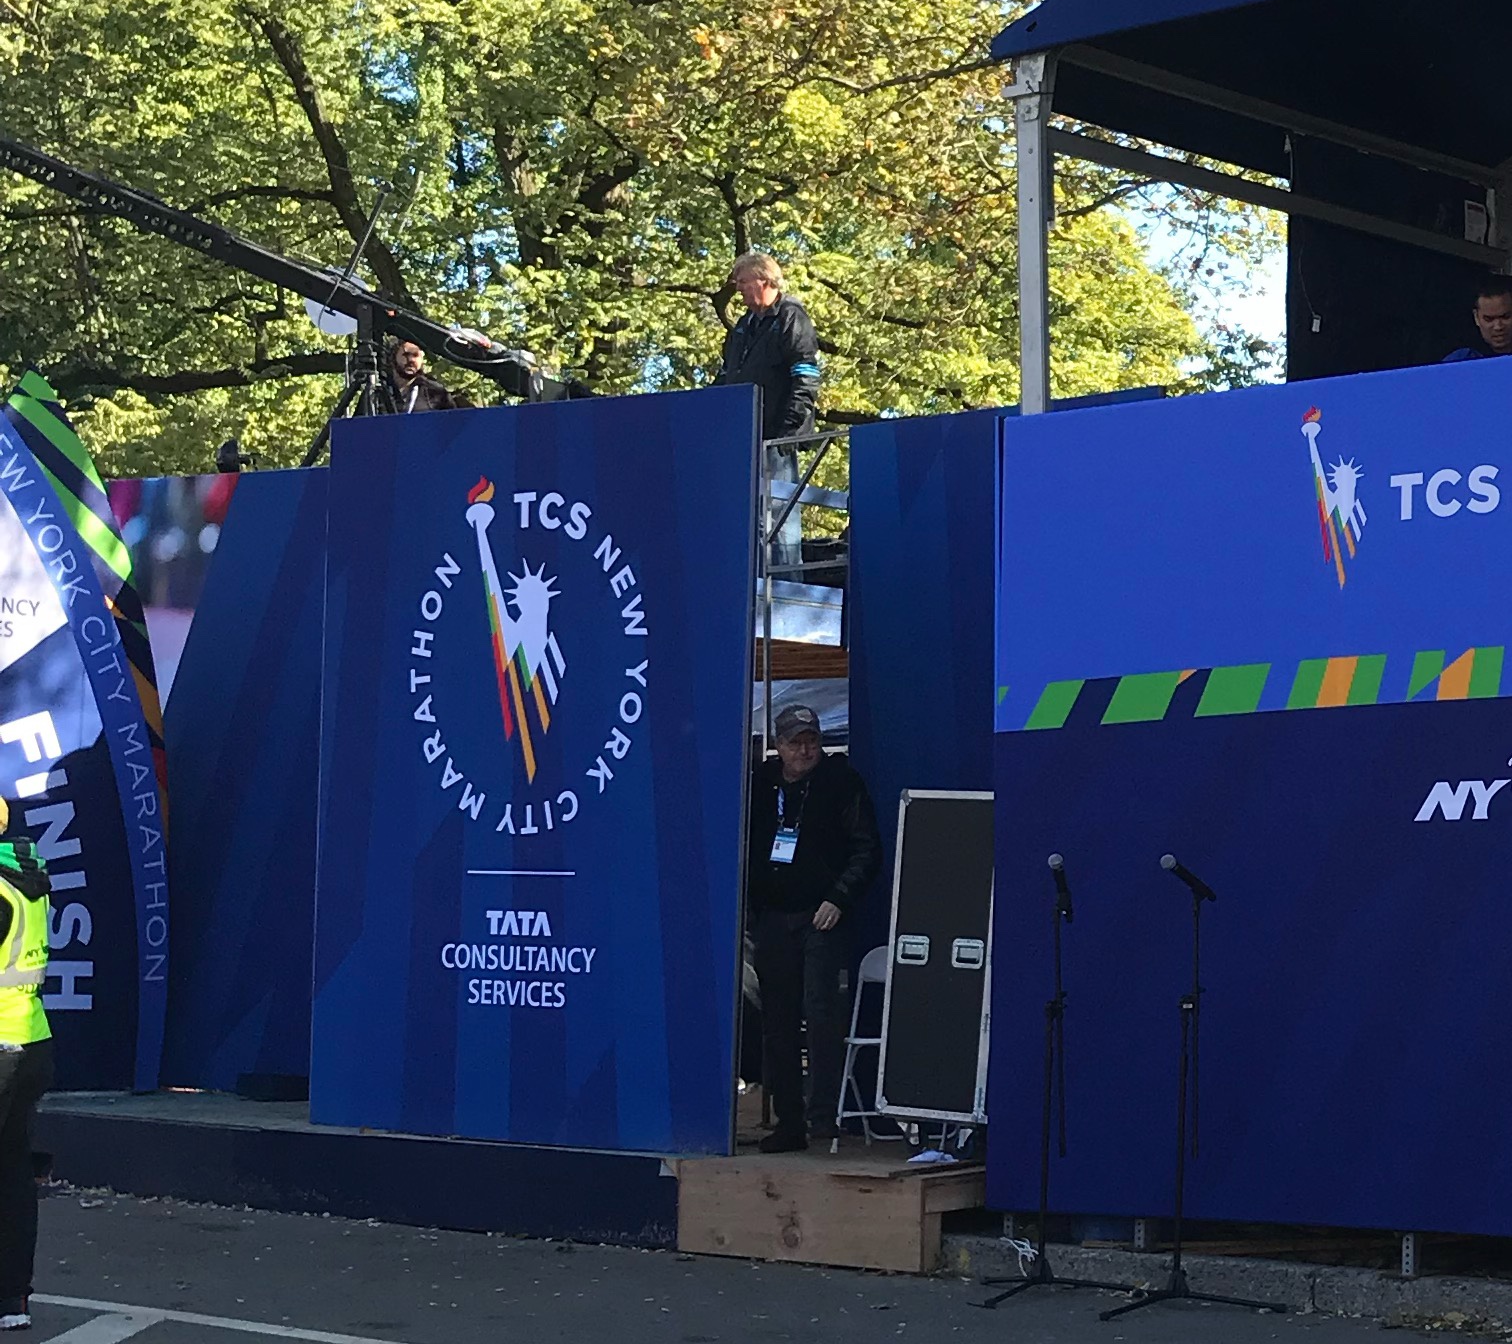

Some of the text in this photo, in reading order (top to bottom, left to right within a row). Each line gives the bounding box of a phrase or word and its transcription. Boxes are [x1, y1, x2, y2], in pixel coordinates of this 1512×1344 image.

[1390, 464, 1501, 521] TCS
[410, 491, 649, 835] TCS NEW YORK CITY MARATHON
[27, 497, 90, 607] YORK
[81, 616, 132, 704] CITY
[117, 722, 168, 982] MARATHON
[0, 710, 94, 1011] FINISH
[486, 910, 551, 937] TATA
[441, 943, 597, 974] CONSULTANCY
[467, 978, 566, 1008] SERVICES
